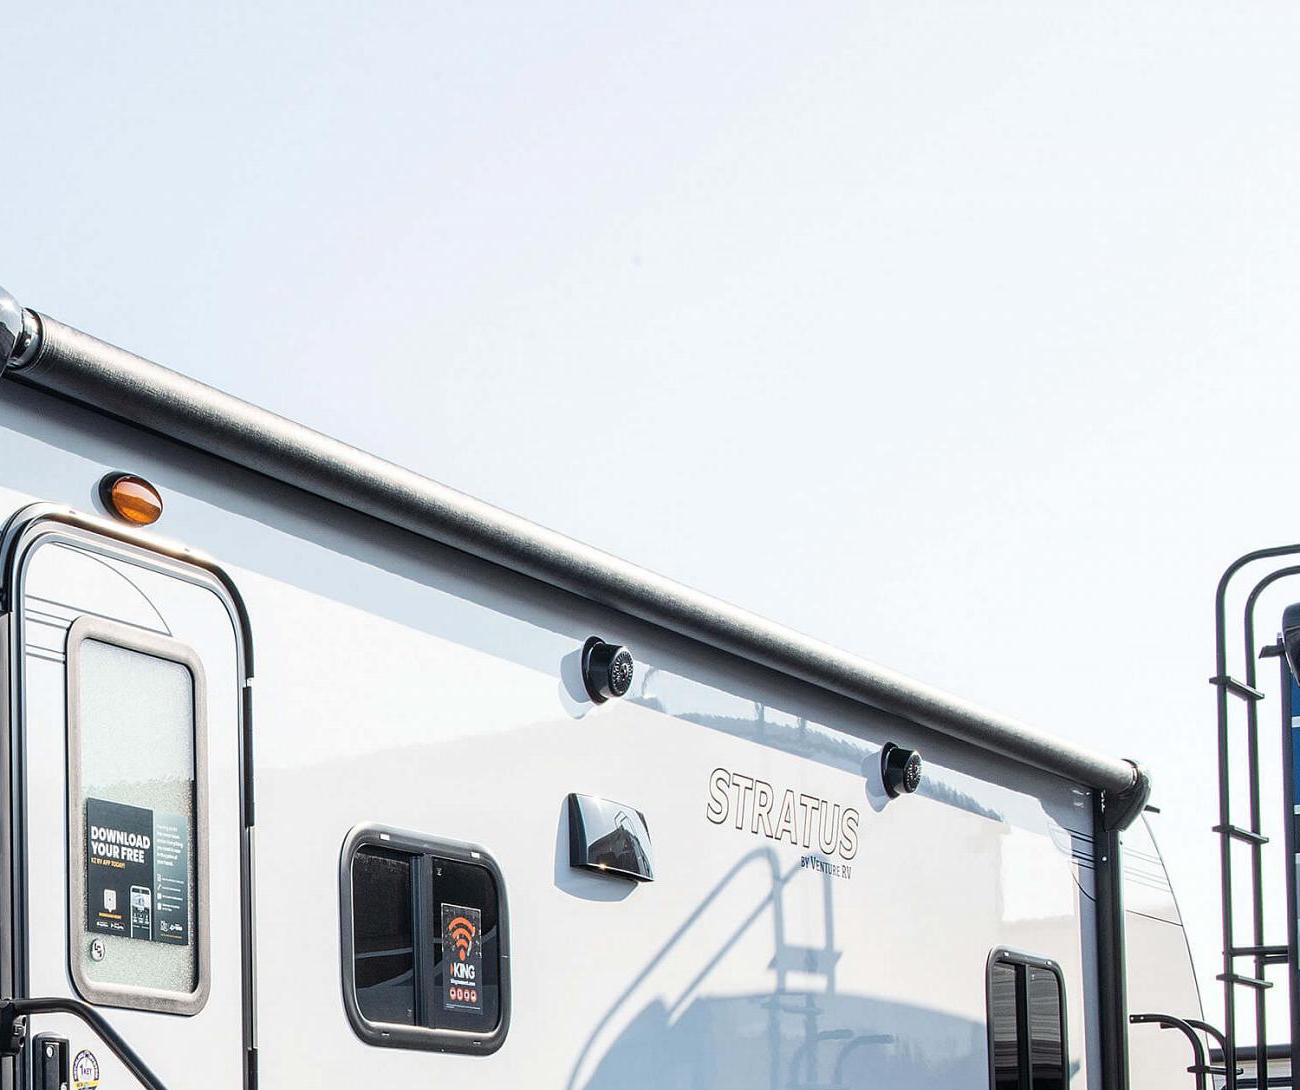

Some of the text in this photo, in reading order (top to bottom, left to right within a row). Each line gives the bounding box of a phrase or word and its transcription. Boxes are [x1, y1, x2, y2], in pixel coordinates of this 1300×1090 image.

[706, 768, 860, 860] STRATUS
[91, 825, 151, 849] DOWNLOAD
[91, 841, 145, 864] YOUR FREE
[800, 855, 810, 869] BY
[453, 961, 476, 980] KING
